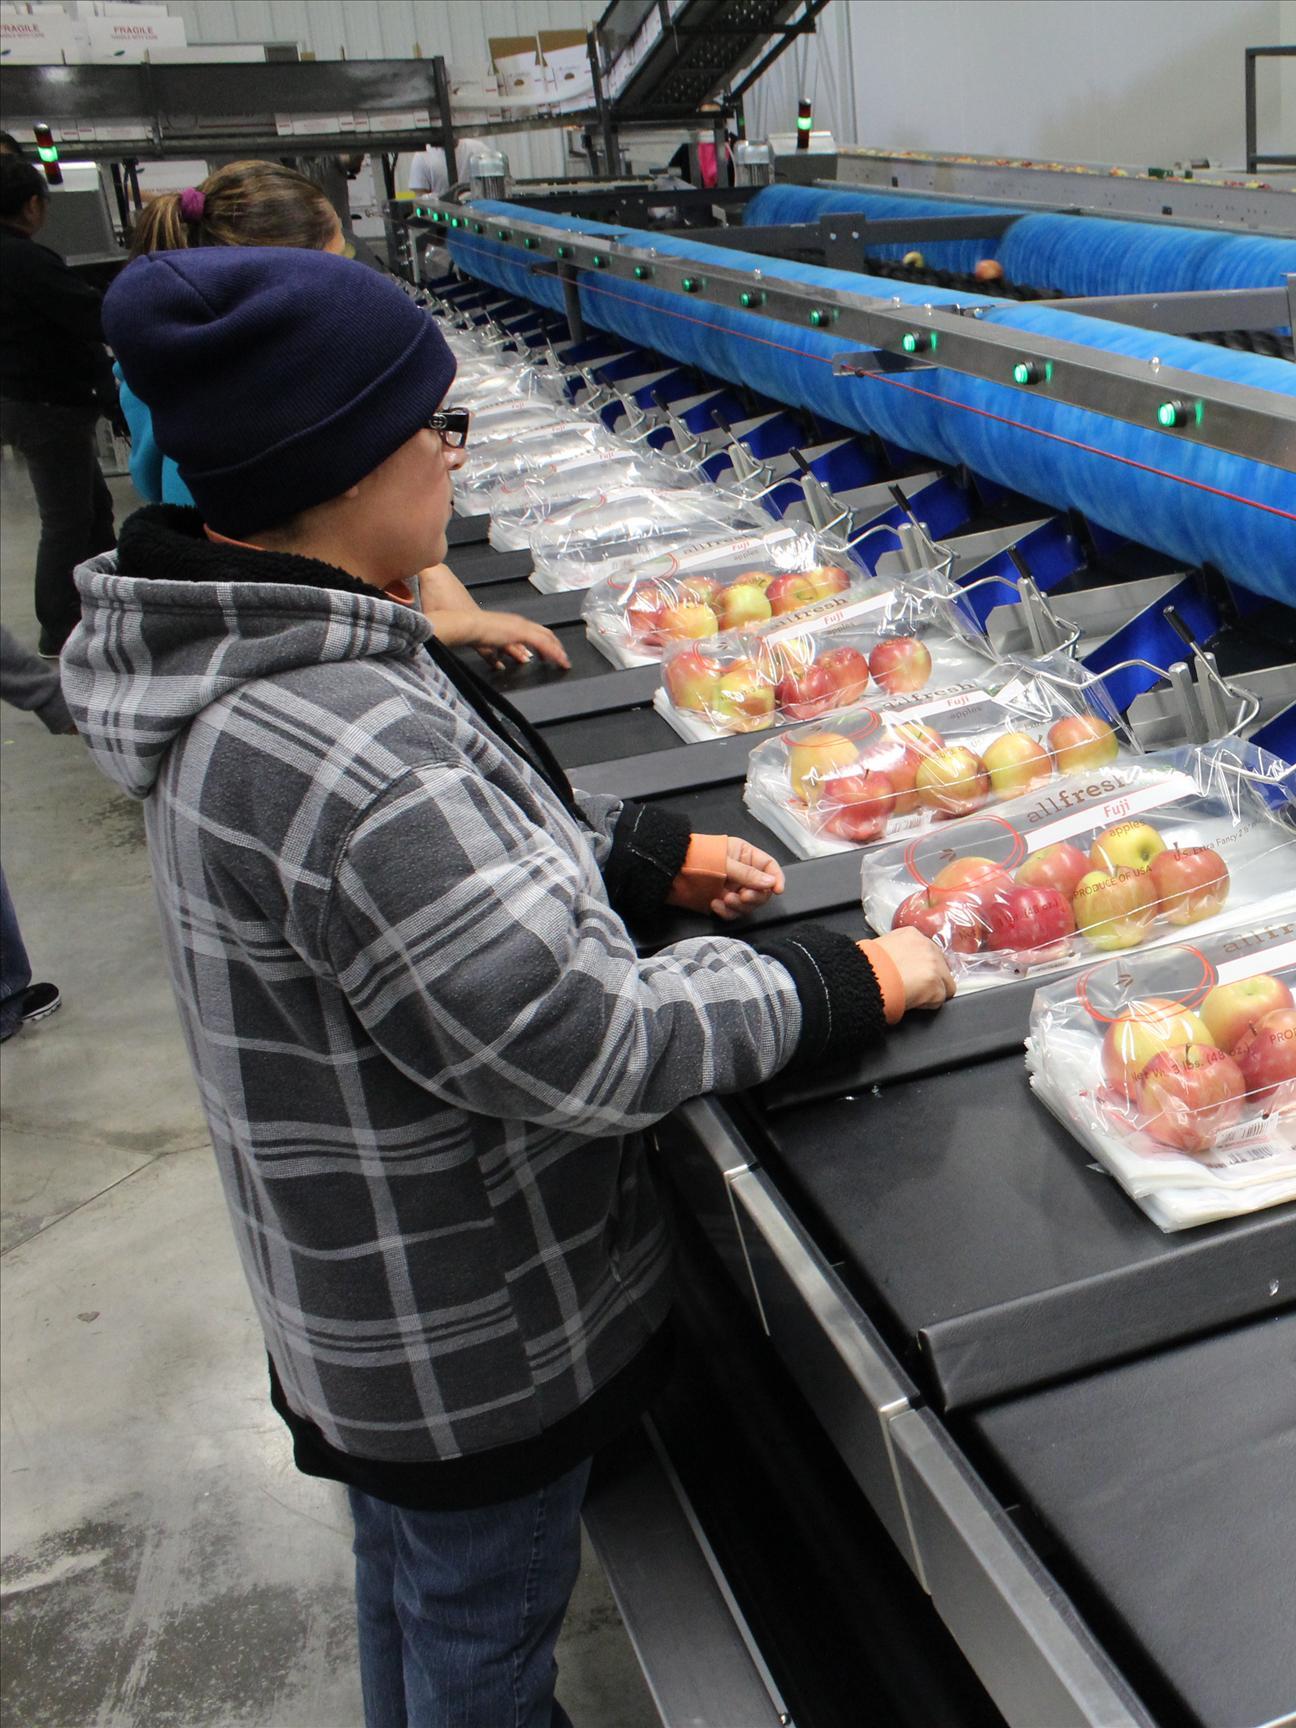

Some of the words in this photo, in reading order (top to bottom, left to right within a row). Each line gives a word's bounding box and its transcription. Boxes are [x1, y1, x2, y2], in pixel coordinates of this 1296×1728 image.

[113, 26, 153, 34] FRAGILE
[823, 613, 845, 625] Fuji
[946, 695, 970, 707] Fuji
[951, 707, 982, 720] apples
[1103, 799, 1131, 818] Fuji
[1109, 818, 1146, 838] apples
[1216, 833, 1238, 848] Fancy
[1073, 878, 1117, 898] PRODUCE
[1119, 873, 1132, 883] OF
[1134, 864, 1153, 877] USA
